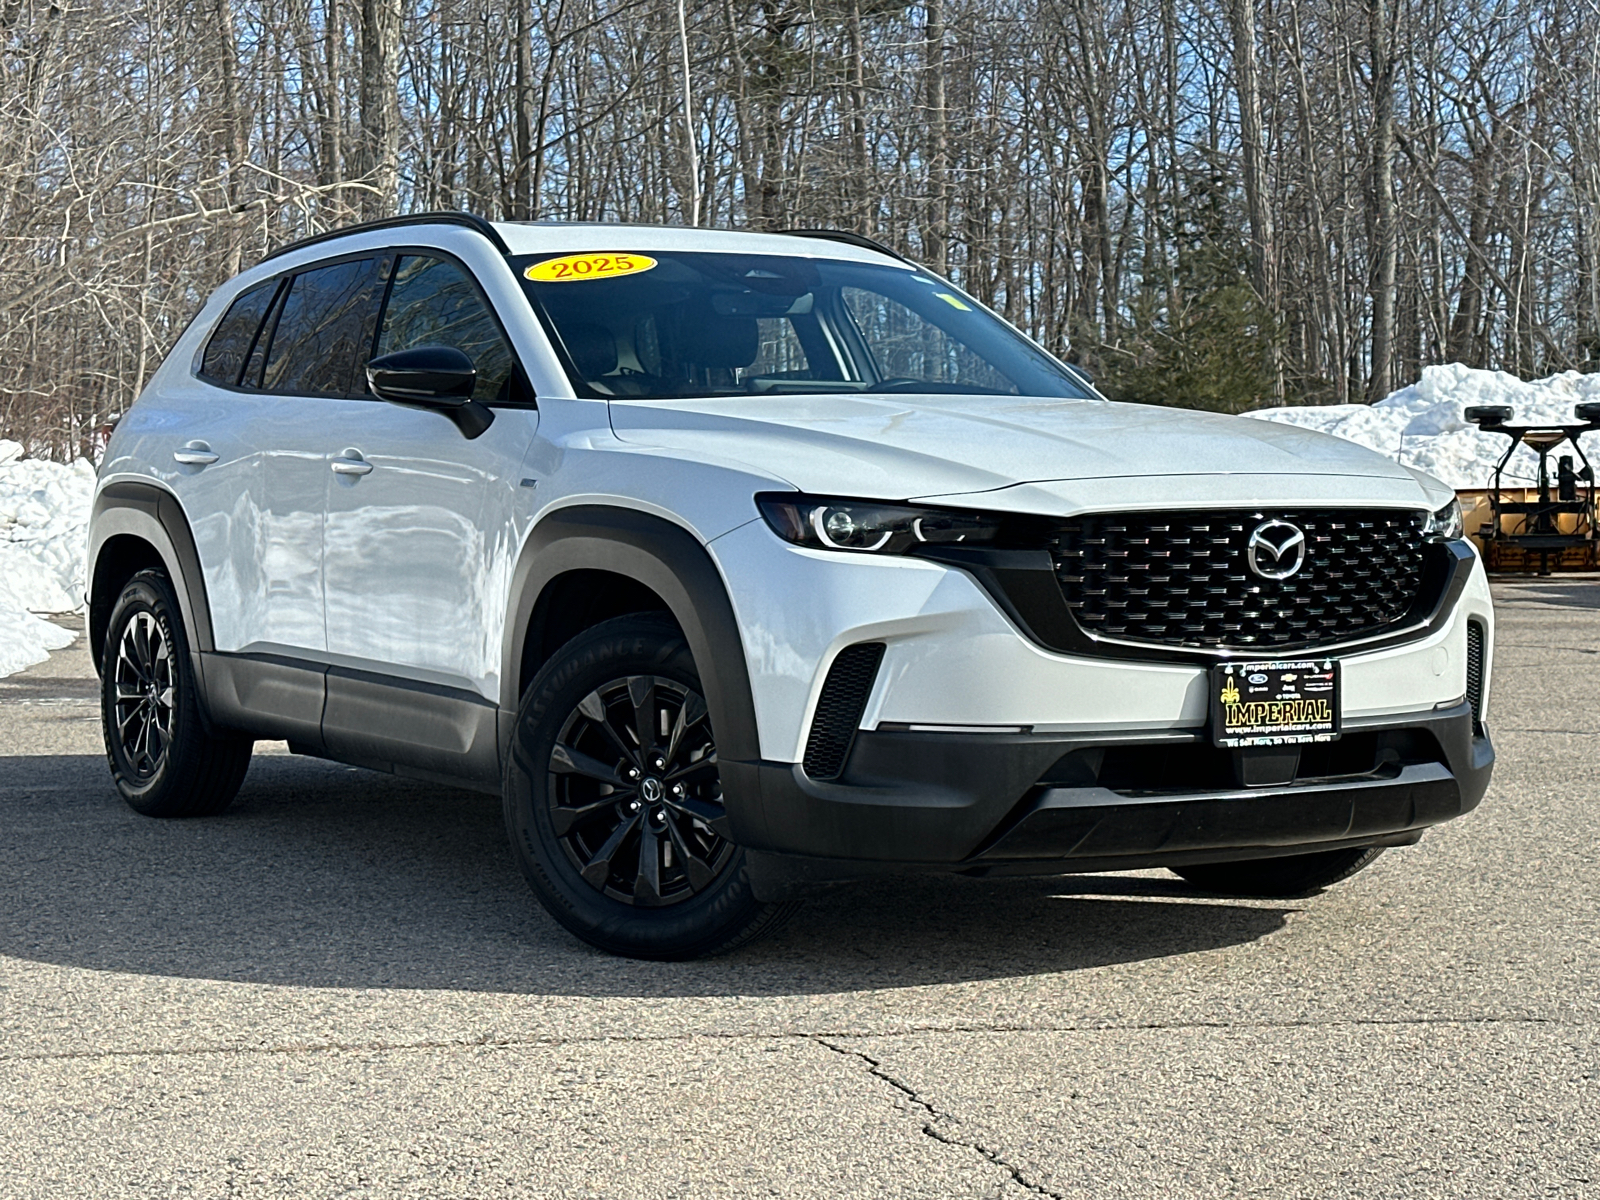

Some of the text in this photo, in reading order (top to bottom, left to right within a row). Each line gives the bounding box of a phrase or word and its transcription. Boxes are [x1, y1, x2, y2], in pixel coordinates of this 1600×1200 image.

[551, 256, 635, 278] 2025
[525, 637, 647, 735] ASSURANCE
[1226, 699, 1332, 726] IMPERIAL
